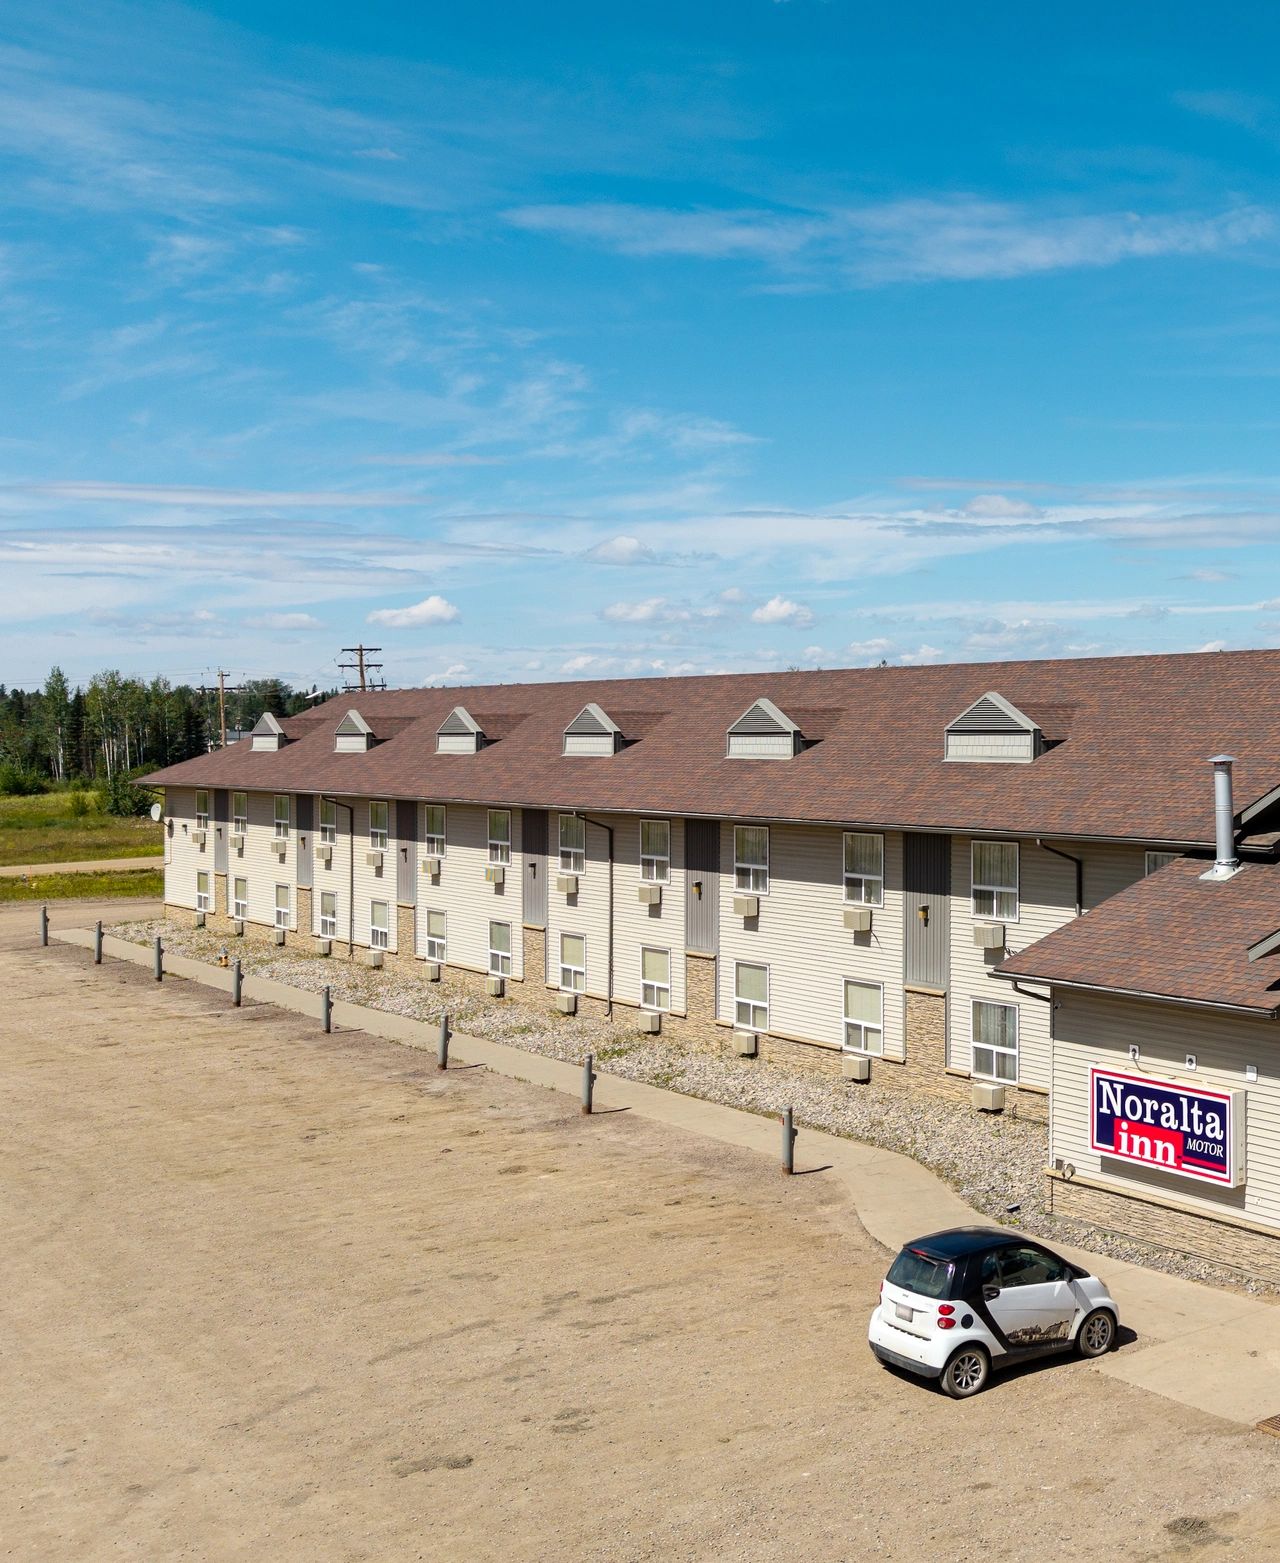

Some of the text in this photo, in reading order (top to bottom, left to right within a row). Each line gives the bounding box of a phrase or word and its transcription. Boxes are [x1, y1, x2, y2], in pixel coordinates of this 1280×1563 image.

[1099, 1080, 1224, 1140] Noralta
[1117, 1121, 1178, 1167] inn
[1186, 1137, 1224, 1158] MOTOR
